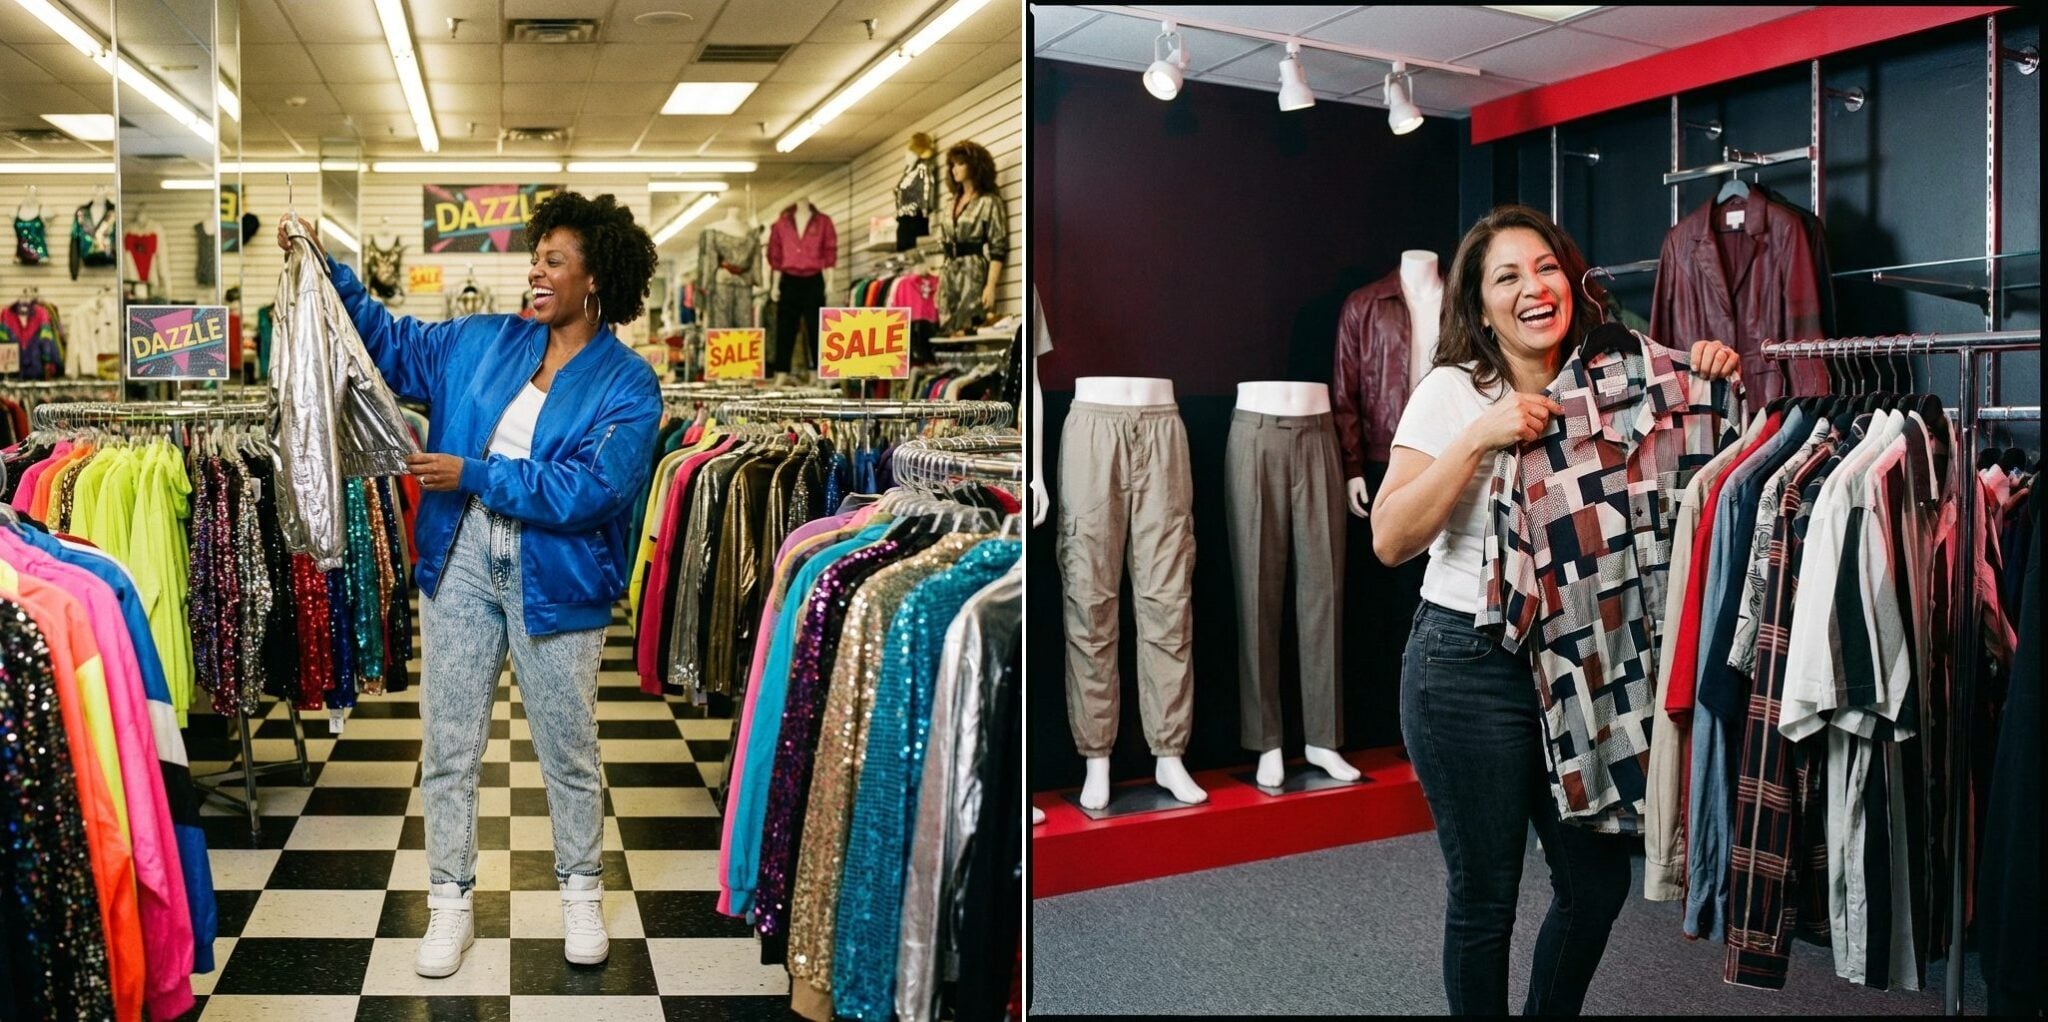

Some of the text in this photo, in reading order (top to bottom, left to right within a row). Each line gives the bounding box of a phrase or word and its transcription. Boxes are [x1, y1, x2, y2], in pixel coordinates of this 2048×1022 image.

[131, 317, 224, 359] DAZZLE
[710, 340, 761, 367] SALE
[825, 323, 904, 362] SALE
